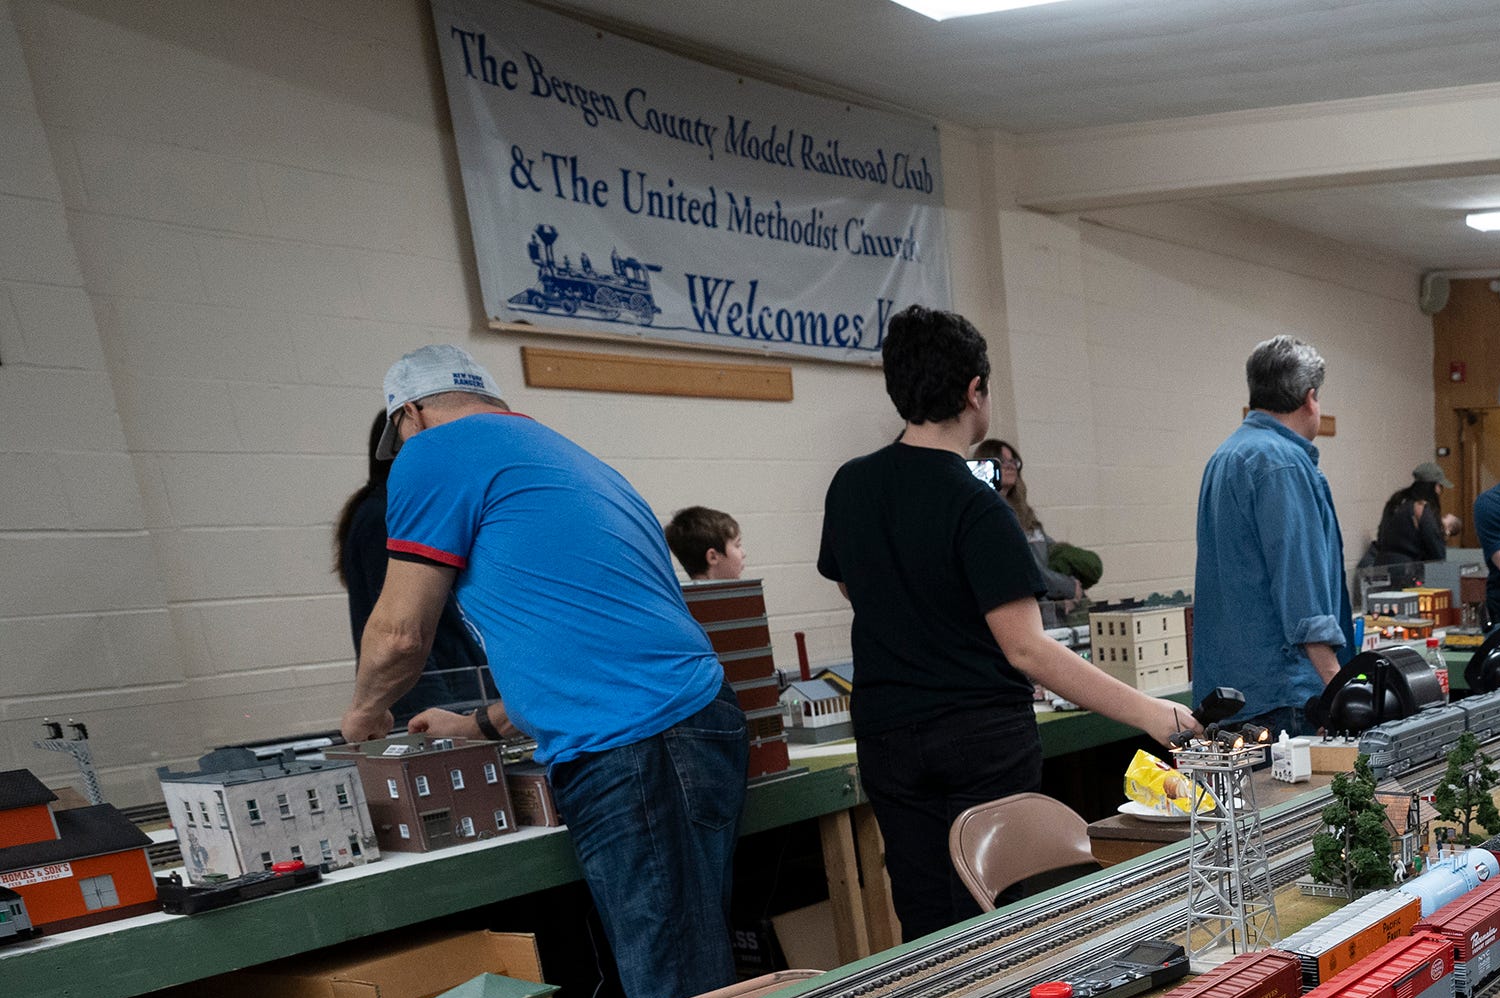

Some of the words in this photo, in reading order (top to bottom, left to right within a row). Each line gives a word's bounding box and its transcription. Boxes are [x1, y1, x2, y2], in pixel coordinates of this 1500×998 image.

[451, 26, 518, 90] The
[523, 51, 622, 127] Bergen
[625, 88, 718, 160] County
[725, 115, 795, 167] Model
[801, 134, 887, 184] Railroad
[892, 153, 934, 194] Club
[511, 144, 541, 192] &
[543, 151, 608, 207] The
[620, 168, 718, 228] United
[726, 191, 838, 251] Methodist
[685, 273, 865, 348] Welcomes
[0, 869, 35, 884] HOMAS
[44, 863, 70, 875] SON'S
